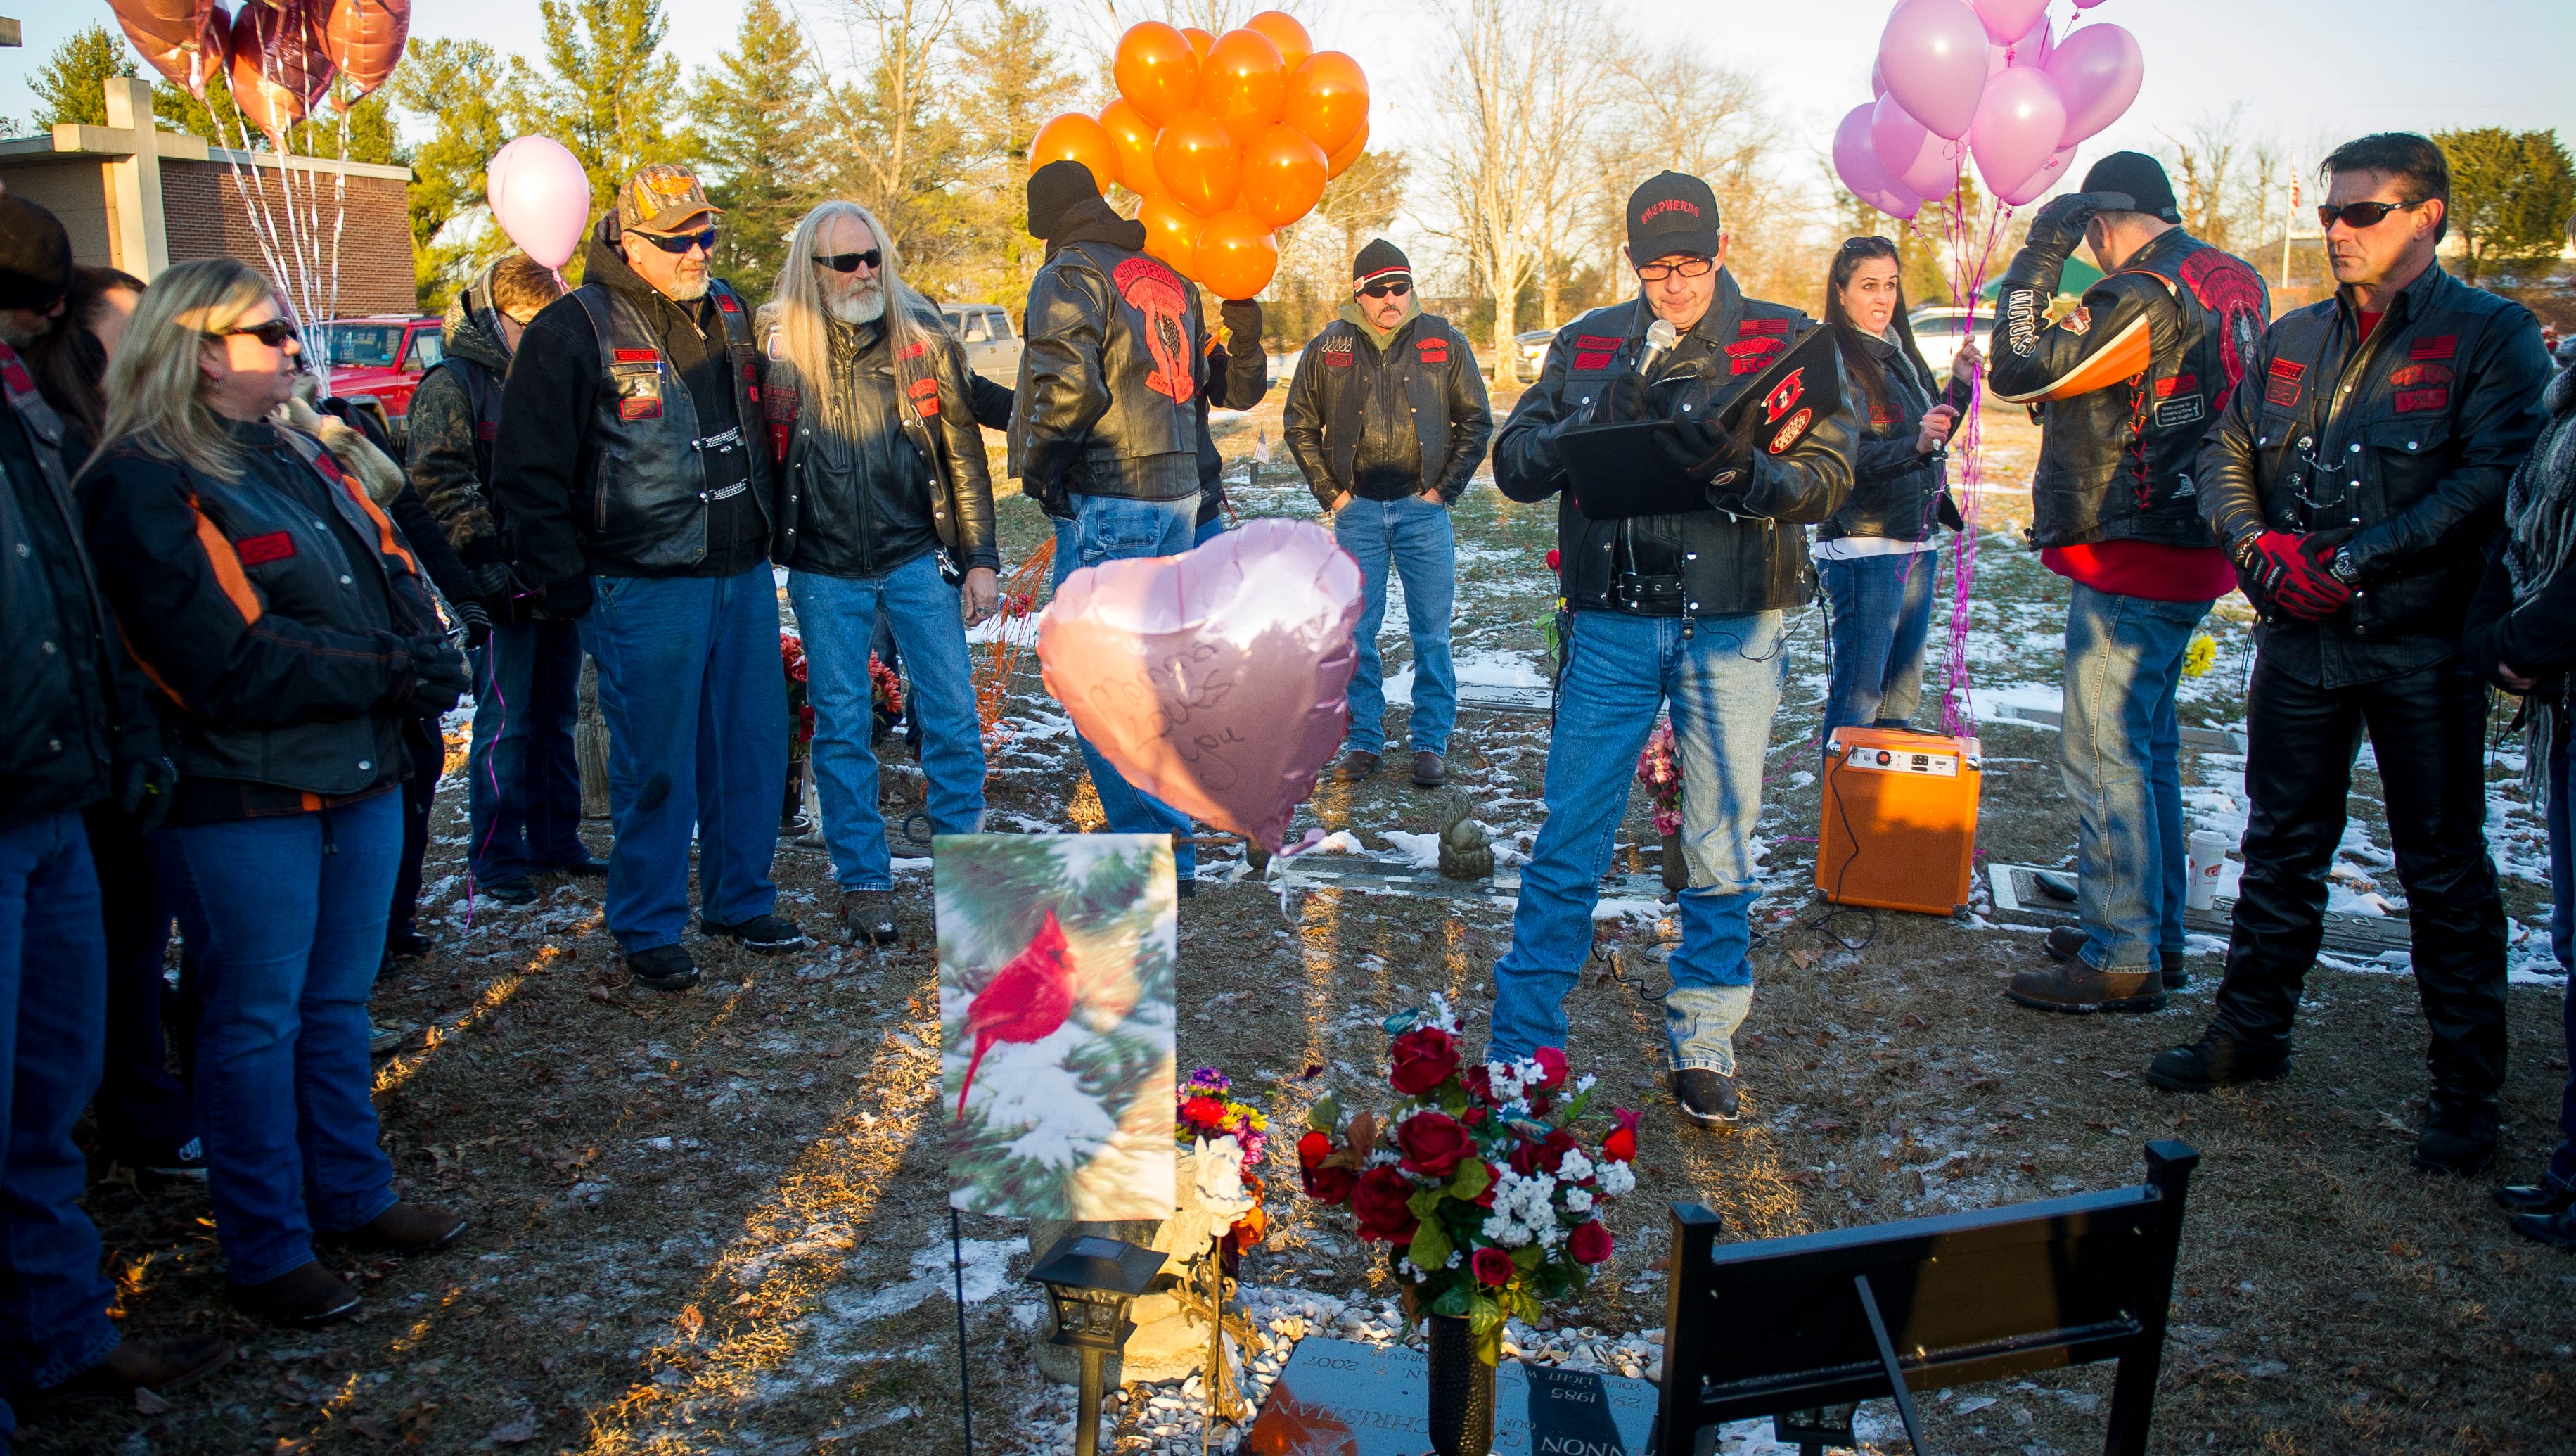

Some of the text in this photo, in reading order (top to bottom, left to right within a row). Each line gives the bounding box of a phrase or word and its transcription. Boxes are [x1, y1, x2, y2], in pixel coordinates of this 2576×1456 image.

[1579, 337, 1620, 347] PRESIDENT
[1741, 359, 1767, 371] RC
[1302, 1355, 1362, 1372] 2007
[1369, 1349, 1429, 1364] OREVER
[1601, 1377, 1642, 1391] YOUR
[1551, 1388, 1597, 1404] 1985
[1269, 1400, 1430, 1434] CHRISTIAN
